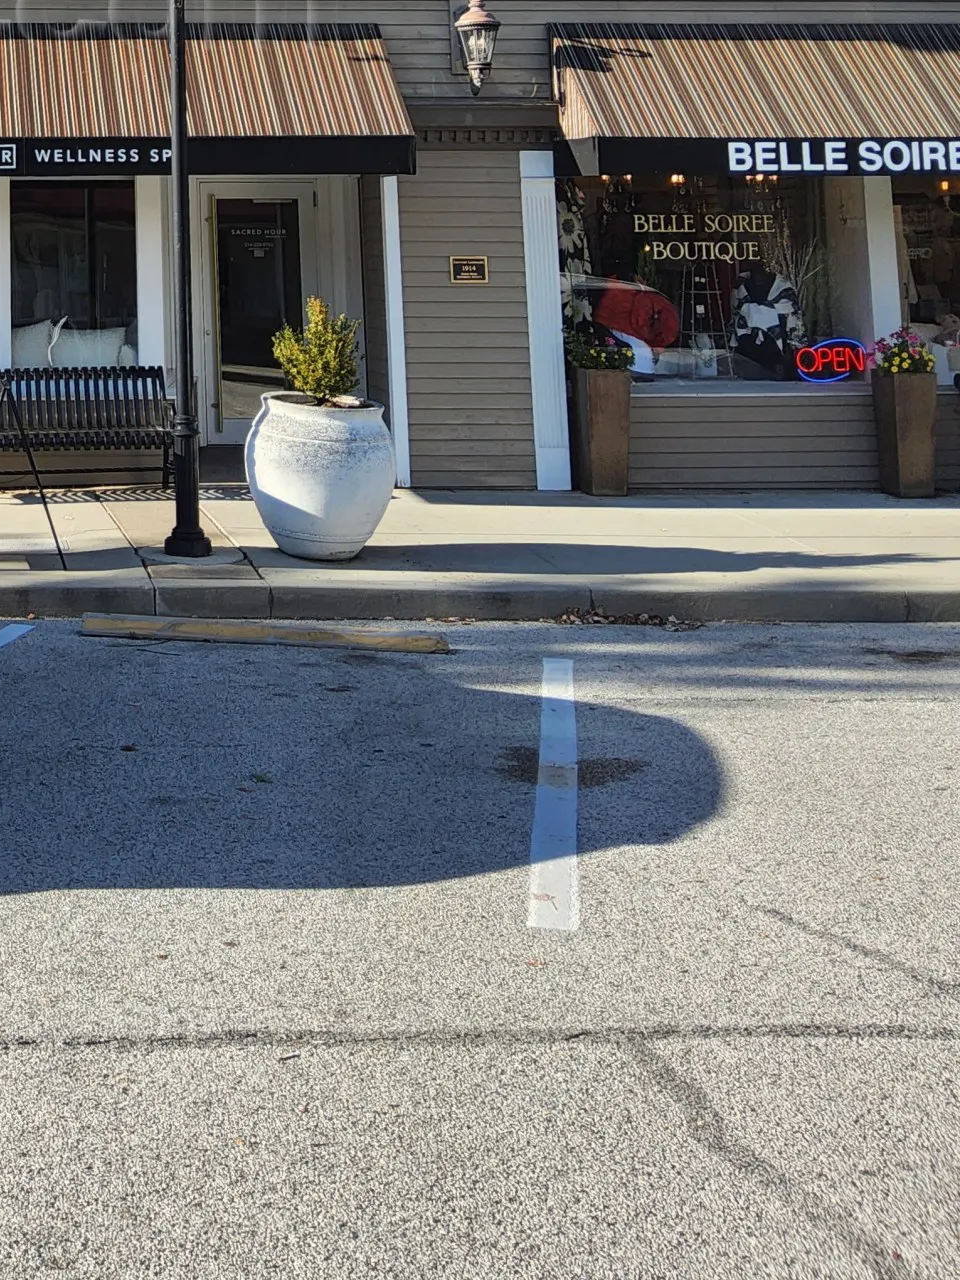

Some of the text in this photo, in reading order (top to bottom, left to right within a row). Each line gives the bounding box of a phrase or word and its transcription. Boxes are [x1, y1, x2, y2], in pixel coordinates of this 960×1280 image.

[34, 149, 140, 163] WELLNESS
[149, 149, 173, 162] SP
[727, 141, 849, 171] BELLE
[231, 228, 262, 236] SACRED
[633, 214, 776, 233] BELLE SOIREE
[652, 241, 761, 264] BOUTIQUE
[796, 347, 865, 373] OPEN
